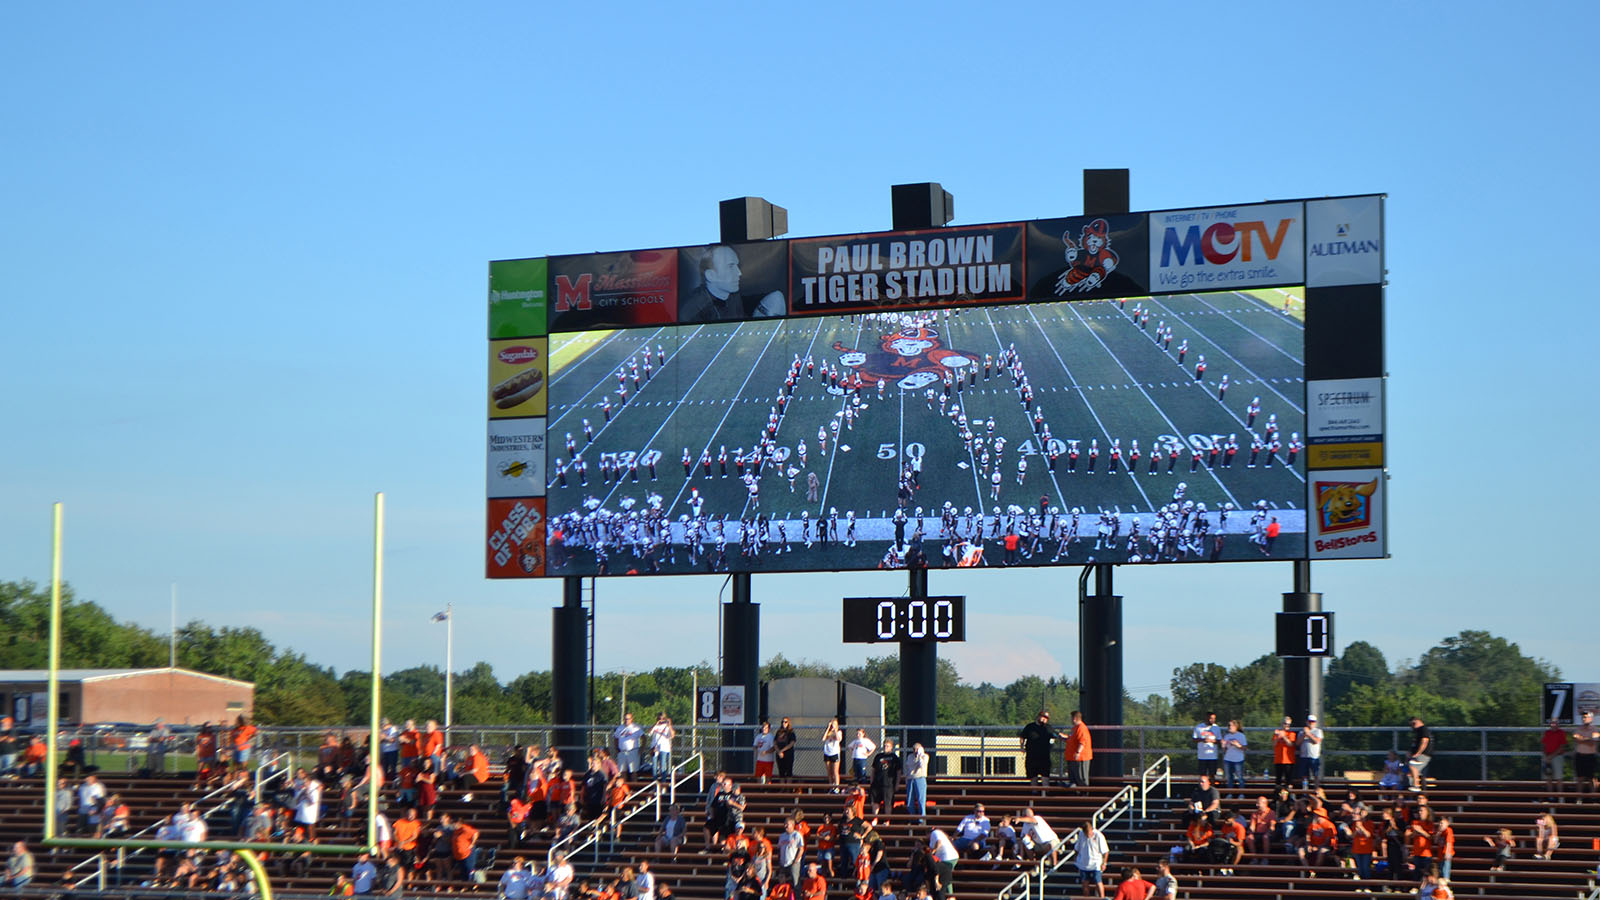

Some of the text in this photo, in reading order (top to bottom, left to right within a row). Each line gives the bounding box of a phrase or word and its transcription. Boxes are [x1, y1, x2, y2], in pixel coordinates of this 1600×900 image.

[1164, 210, 1238, 224] INTERNET TV PHONE
[818, 235, 993, 274] PAUL BROWN
[1309, 239, 1380, 257] AULTMAN
[801, 264, 1011, 304] TIGER STADIUM
[1159, 272, 1178, 285] We
[1179, 271, 1195, 287] go
[1197, 269, 1215, 283] the
[1217, 268, 1245, 281] extra
[555, 274, 592, 312] M
[599, 295, 665, 307] CITY SCHOOLS
[1318, 391, 1370, 406] SPECTRUM
[489, 434, 544, 444] MIDWESTERN
[488, 502, 528, 551] CLASS
[494, 507, 542, 567] OF 1983
[877, 600, 953, 638] 0:00
[1307, 615, 1328, 652] 0
[702, 691, 714, 718] 8
[1551, 690, 1566, 720] 7
